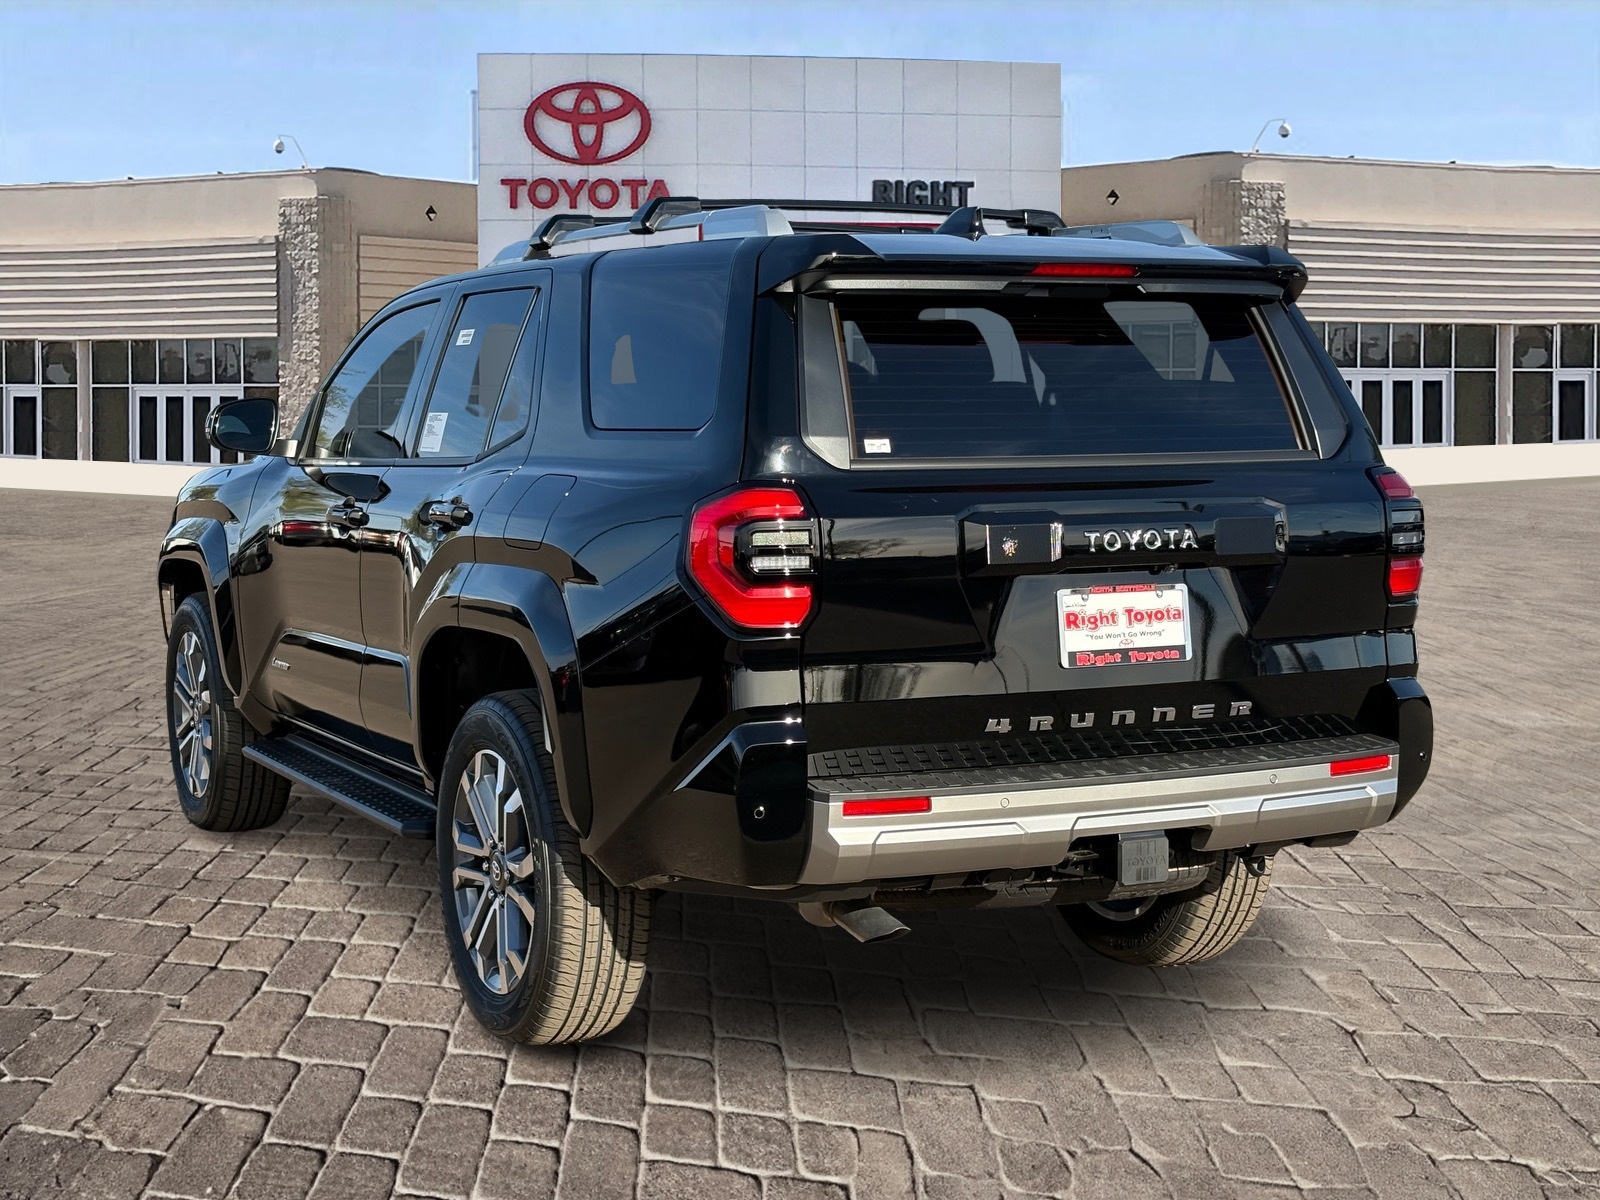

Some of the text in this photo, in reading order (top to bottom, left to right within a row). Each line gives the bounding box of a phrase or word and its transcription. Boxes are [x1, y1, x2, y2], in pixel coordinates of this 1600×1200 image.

[500, 178, 671, 209] TOYOTA
[872, 179, 975, 207] RIGHT
[1084, 526, 1199, 553] TOYOTA
[1064, 605, 1184, 632] Right Toyota
[1105, 631, 1127, 639] Won't
[1076, 649, 1180, 666] Right Toyota
[985, 701, 1253, 733] 4RUNNER
[1126, 855, 1167, 868] TOYOTA
